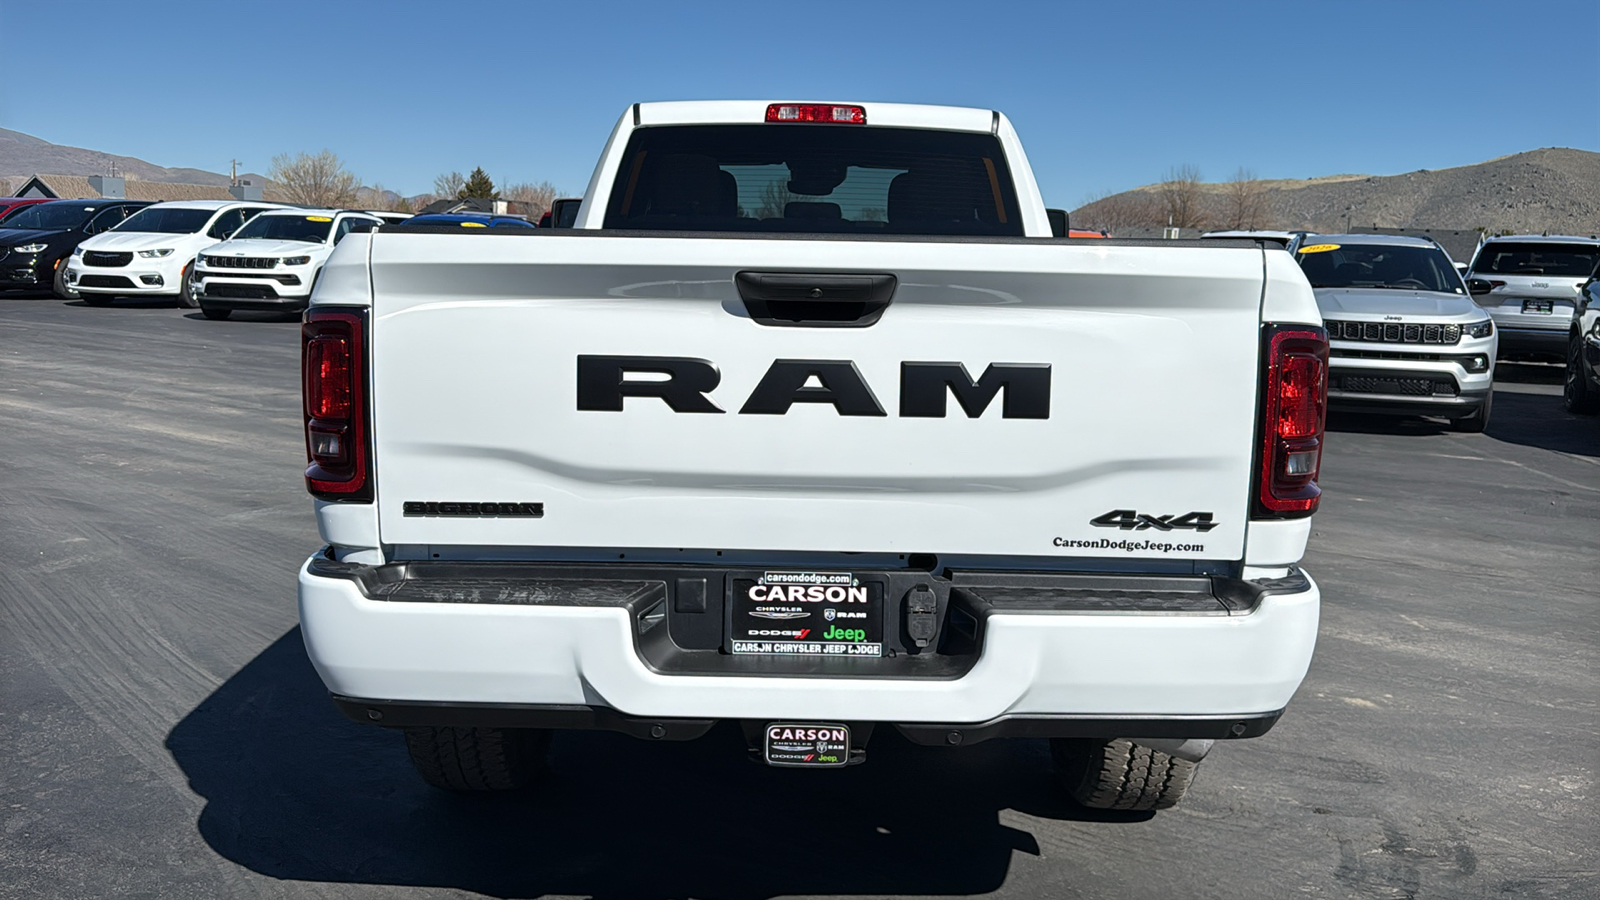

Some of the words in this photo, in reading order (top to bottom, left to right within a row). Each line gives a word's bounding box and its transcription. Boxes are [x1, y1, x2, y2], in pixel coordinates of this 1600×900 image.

[577, 354, 1052, 419] RAM
[1089, 509, 1220, 532] 4x4
[1053, 537, 1204, 552] CarsonDodgeJeep.com
[767, 573, 850, 584] carsondodge.com
[749, 586, 867, 602] CARSON
[823, 625, 866, 643] Jeep
[773, 644, 821, 654] CHRYSLER
[823, 645, 846, 654] JEEP
[770, 729, 844, 741] CARSON
[818, 754, 838, 762] Jeep
